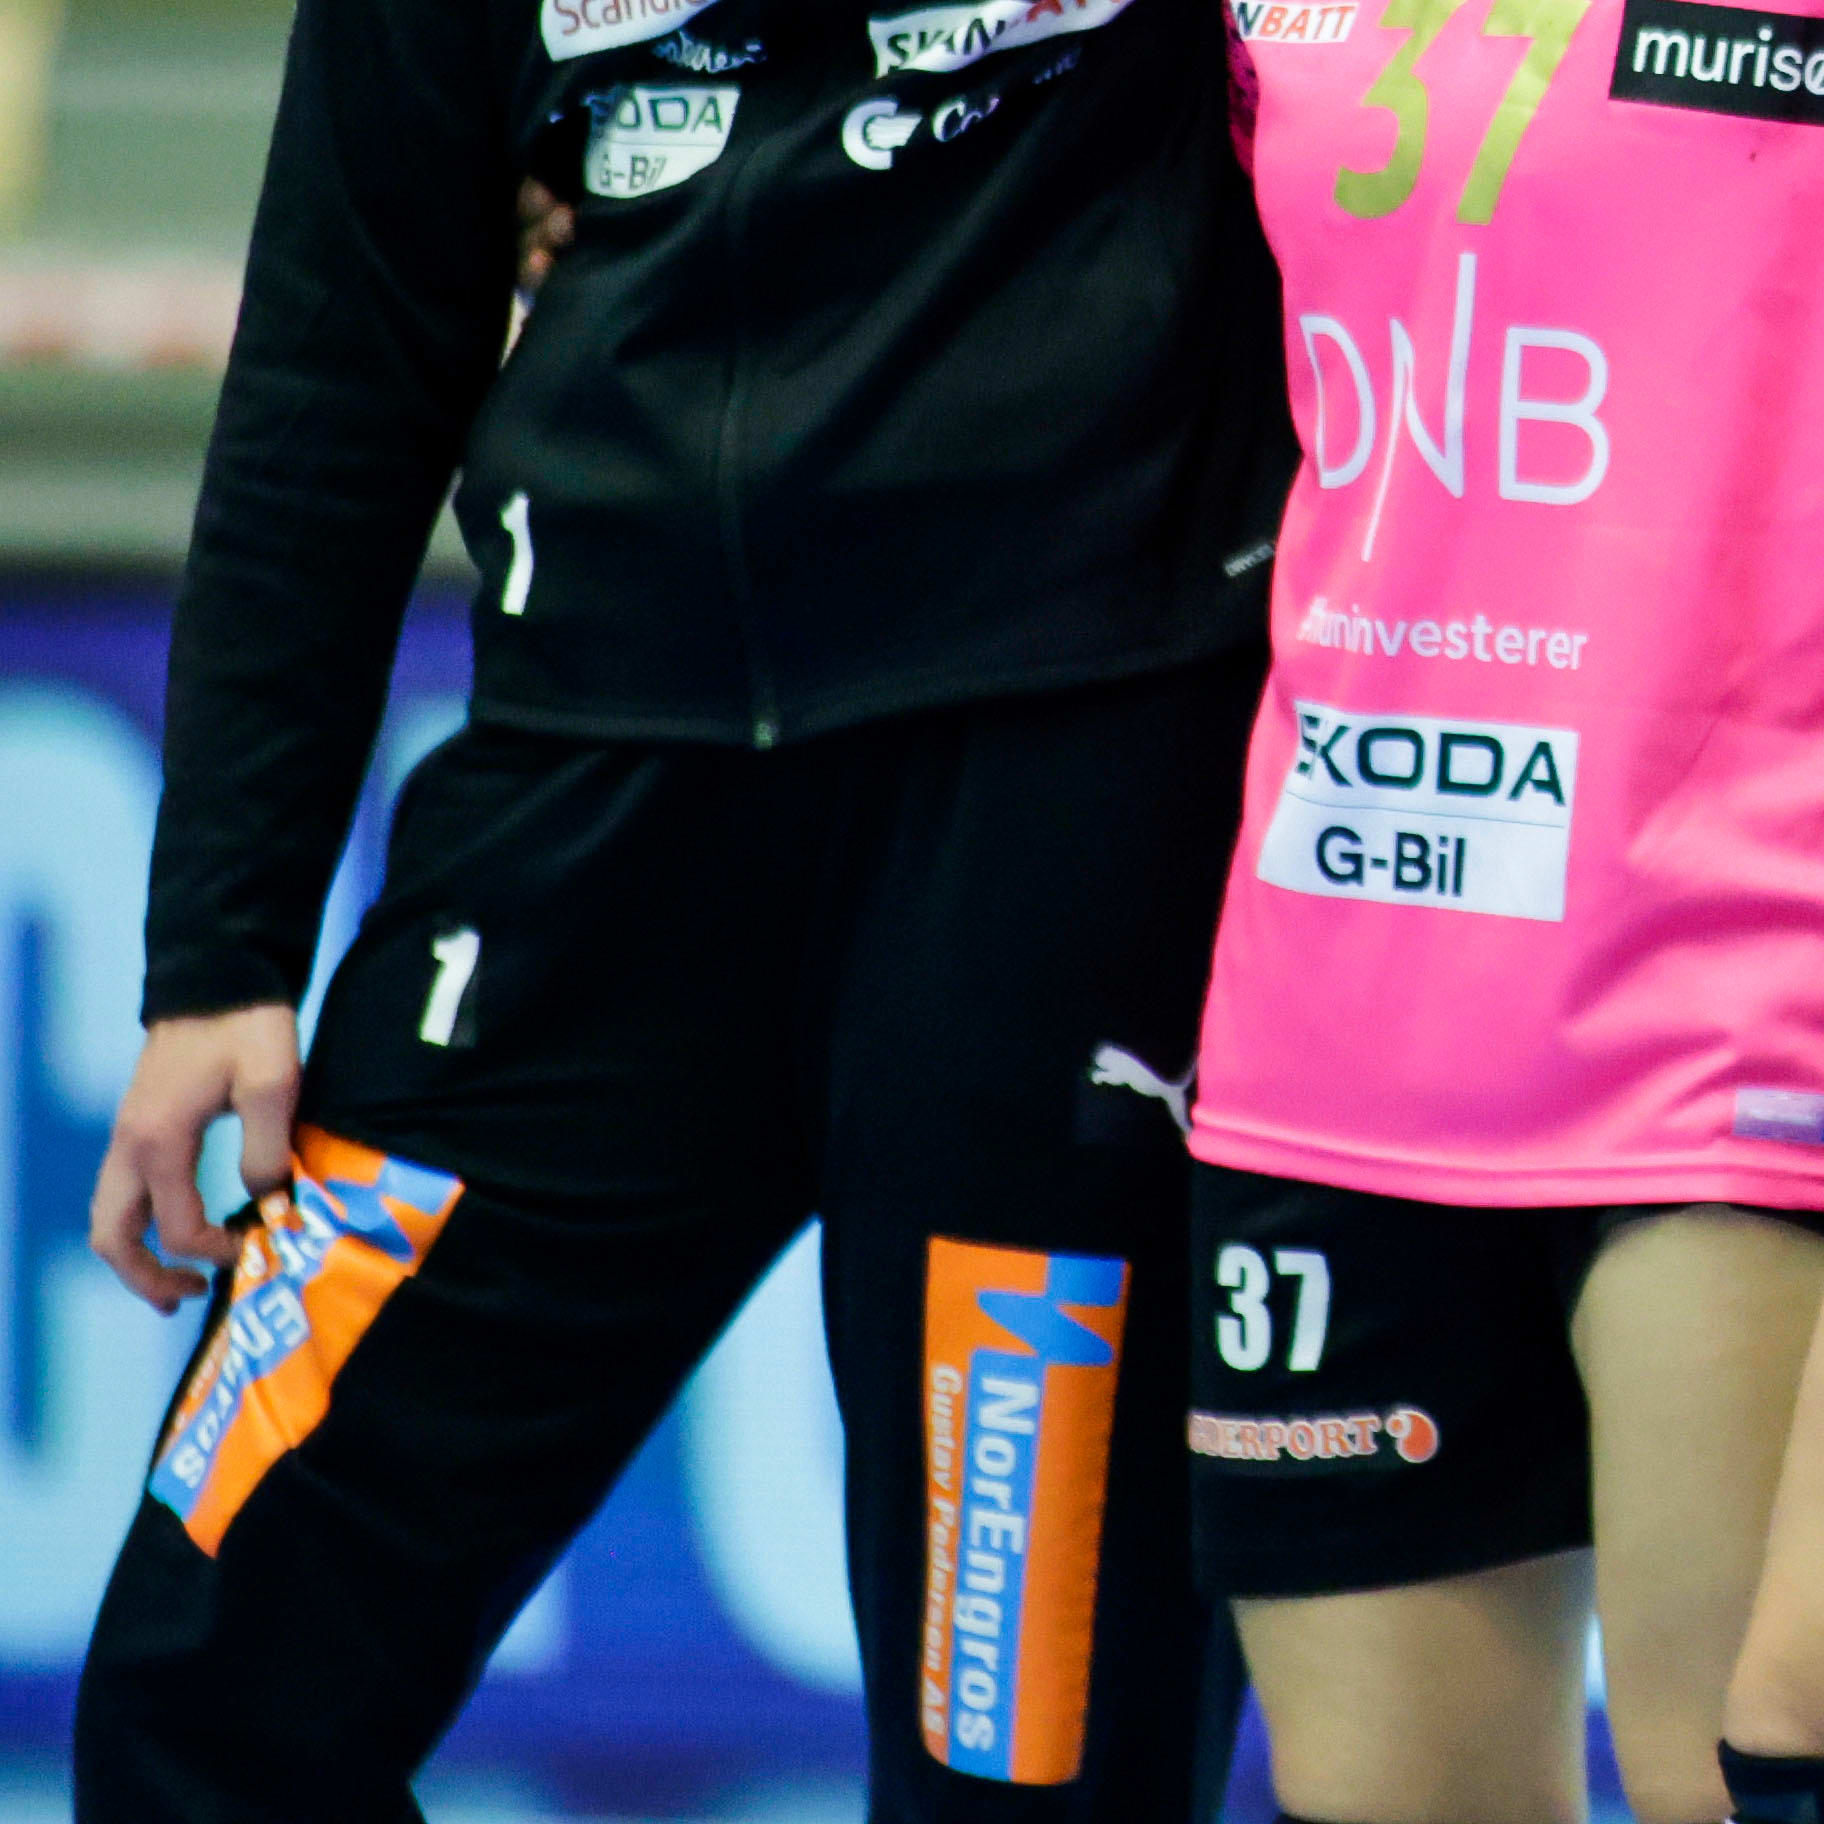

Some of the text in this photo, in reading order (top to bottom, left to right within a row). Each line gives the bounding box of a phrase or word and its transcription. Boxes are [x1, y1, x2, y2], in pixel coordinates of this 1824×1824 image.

[1236, 1, 1357, 40] NBATT
[1299, 252, 1610, 562] DNB
[499, 491, 534, 616] 1
[1315, 825, 1467, 897] G-Bil
[420, 927, 480, 1046] 1
[1215, 1242, 1333, 1372] 37
[953, 1374, 1040, 1752] NorEngros
